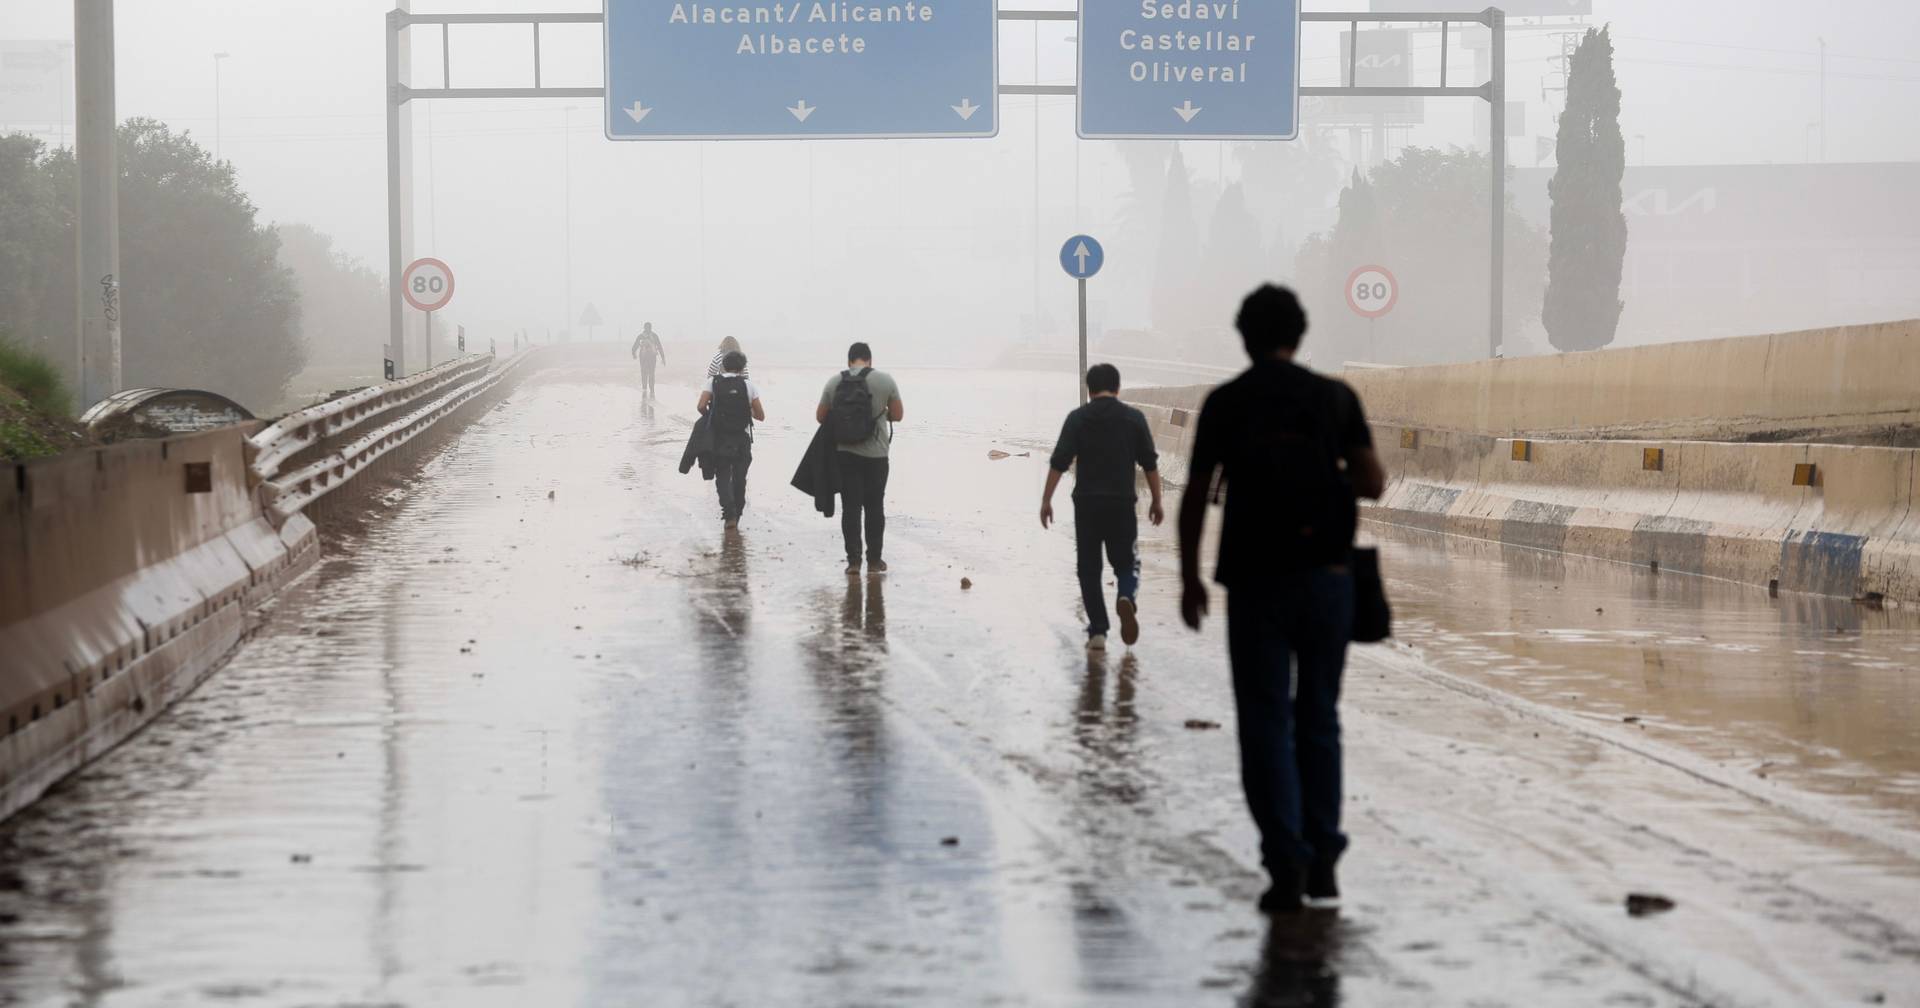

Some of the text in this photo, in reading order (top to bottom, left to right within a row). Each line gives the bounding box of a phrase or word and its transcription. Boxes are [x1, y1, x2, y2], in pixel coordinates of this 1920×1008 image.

[1141, 0, 1239, 19] Sedaví
[736, 33, 866, 54] Albacete
[1120, 29, 1255, 51] Castellar
[1130, 61, 1246, 82] Oliveral
[413, 276, 443, 293] 80
[1357, 283, 1386, 300] 80
